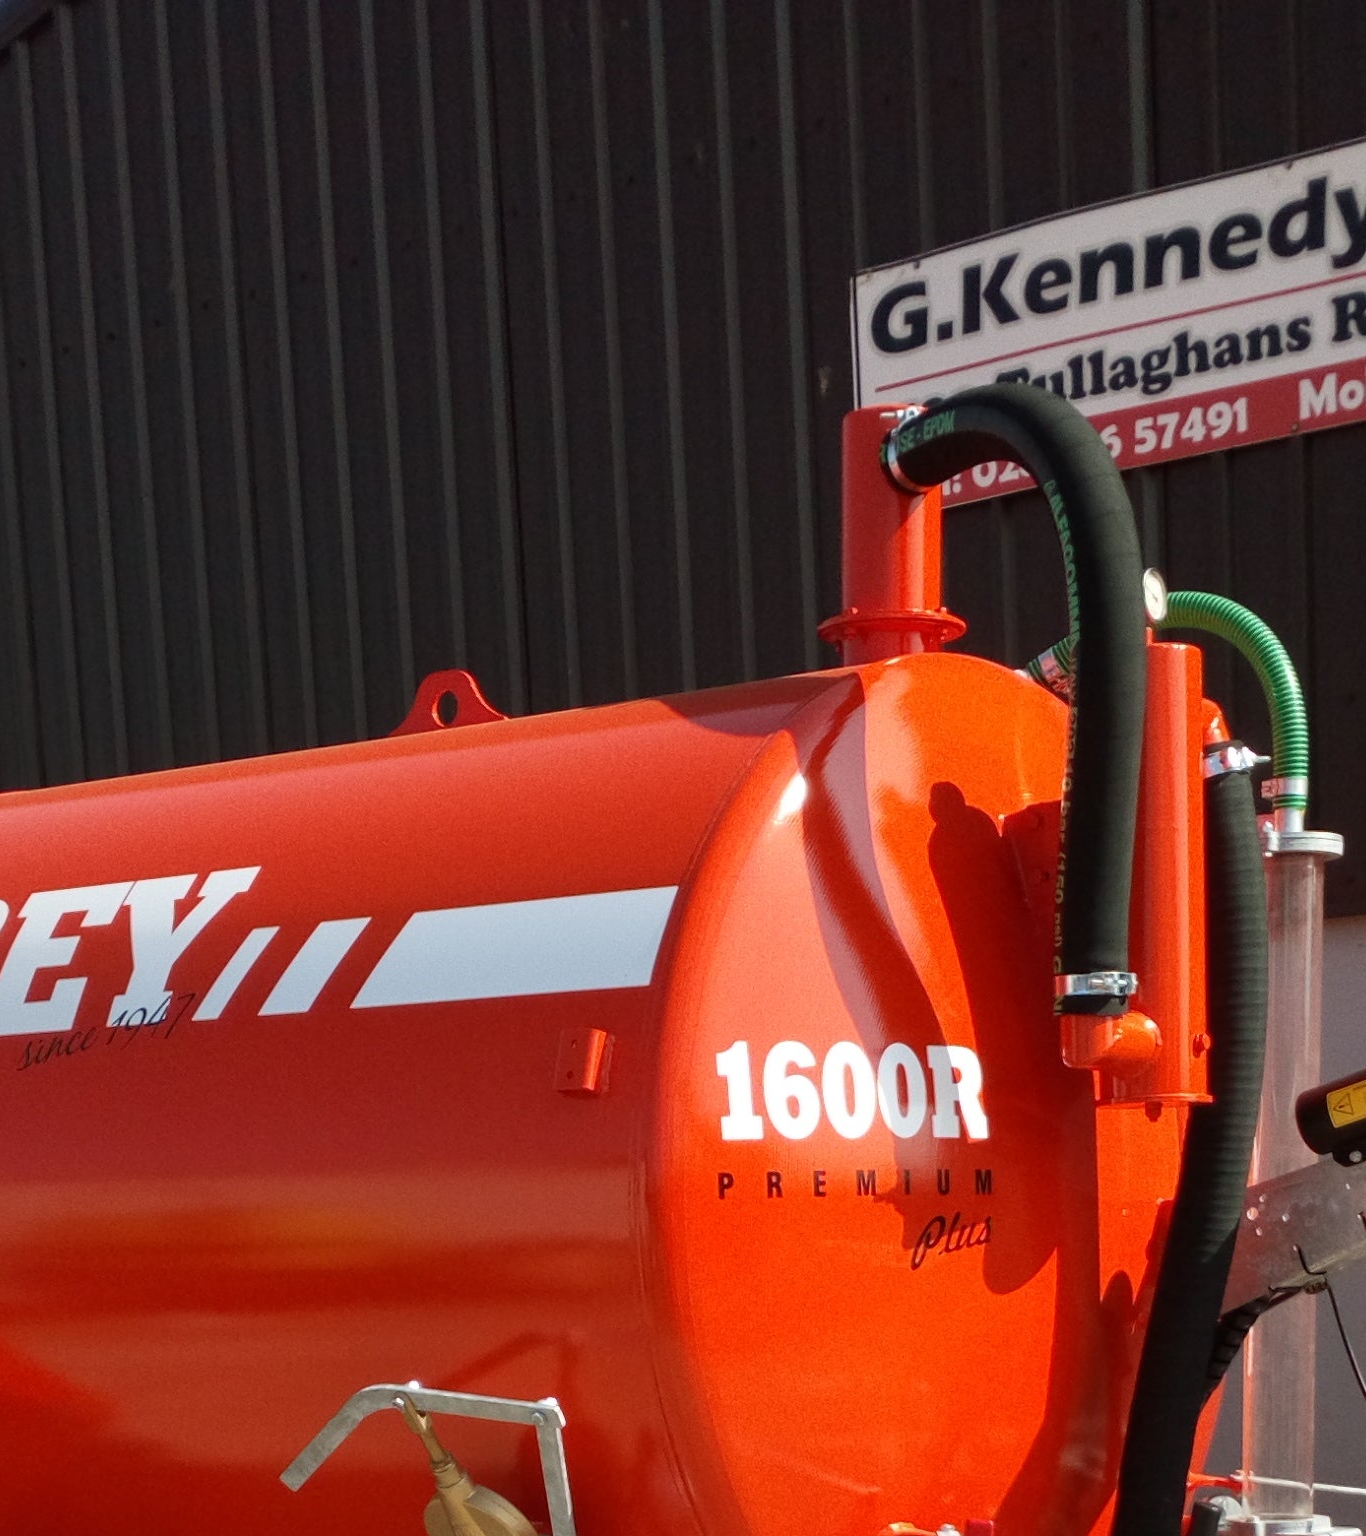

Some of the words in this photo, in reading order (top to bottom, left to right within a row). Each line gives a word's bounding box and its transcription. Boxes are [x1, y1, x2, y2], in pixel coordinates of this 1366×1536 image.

[1133, 397, 1249, 455] 57491
[16, 1026, 98, 1071] since
[105, 992, 197, 1050] 1947
[715, 1040, 990, 1141] 1600R
[717, 1169, 993, 1200] PREMIUM
[910, 1211, 993, 1270] Plus
